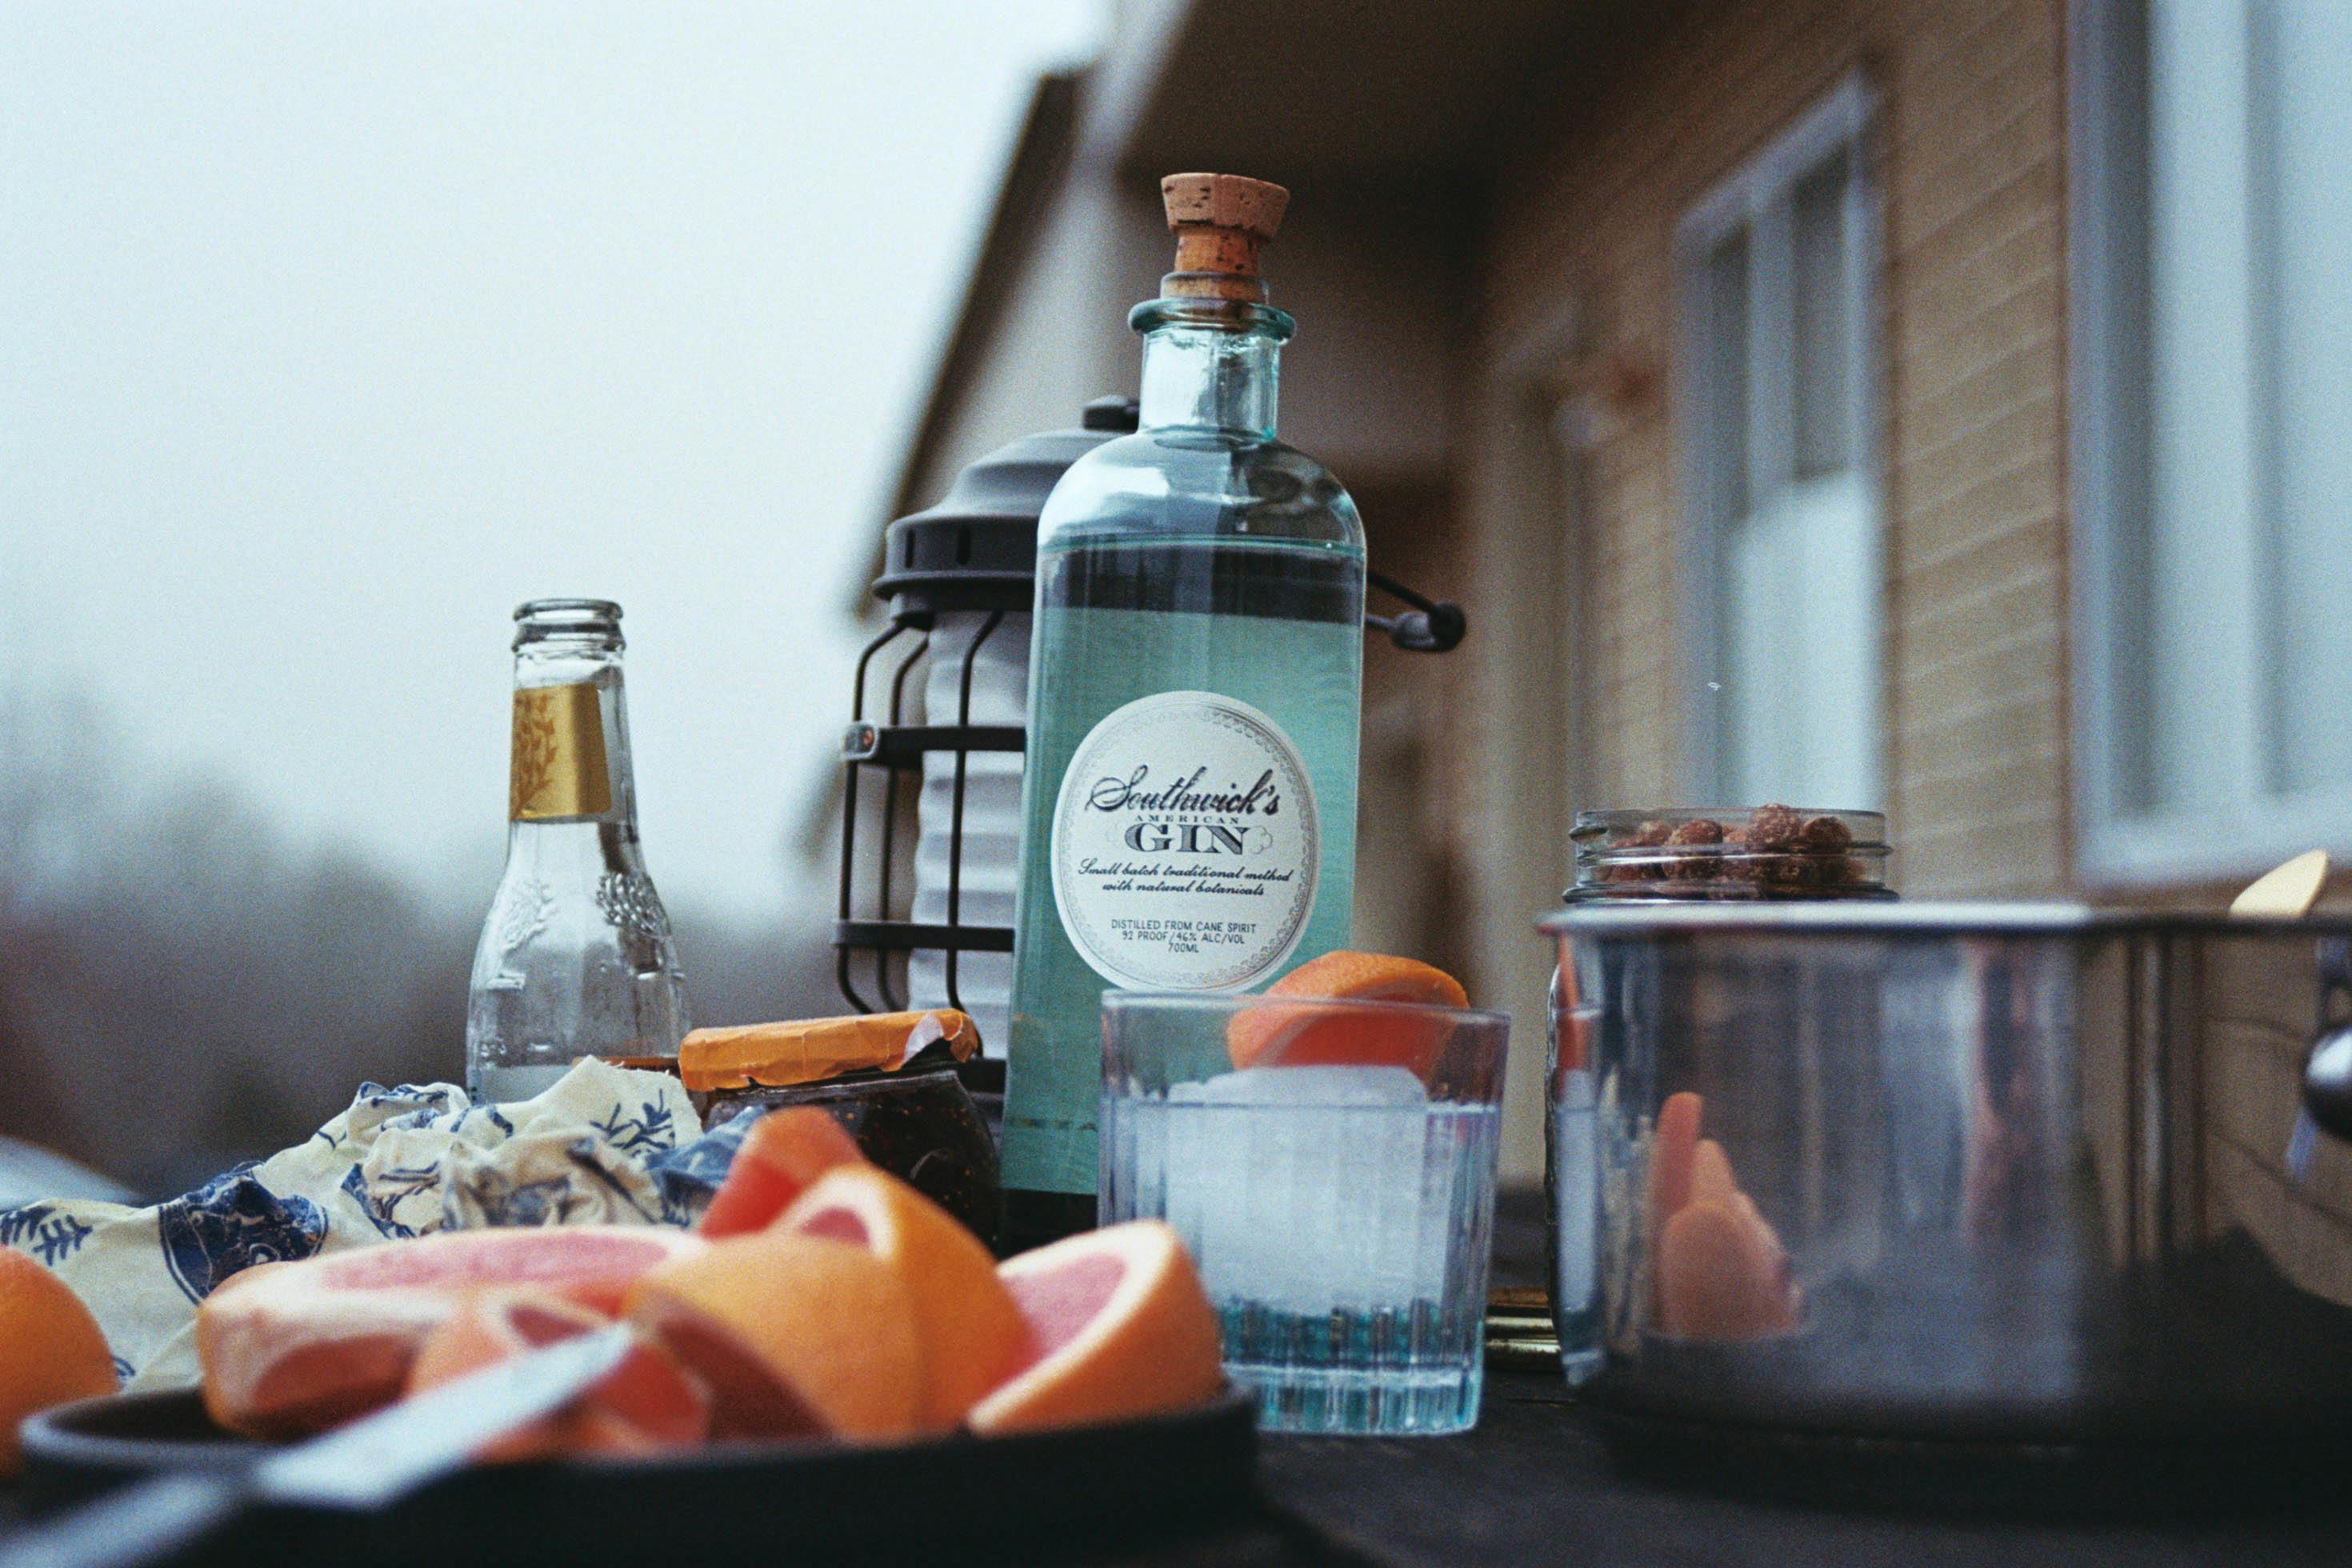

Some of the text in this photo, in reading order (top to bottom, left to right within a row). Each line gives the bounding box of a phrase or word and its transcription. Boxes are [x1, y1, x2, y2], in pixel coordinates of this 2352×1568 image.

[1084, 764, 1280, 815] Southwick's
[1134, 814, 1241, 825] AMERICAN
[1124, 822, 1250, 855] GIN
[1078, 858, 1294, 882] Small batch traditional method
[1102, 879, 1264, 896] with natural botanicals
[1111, 918, 1257, 934] DISTILLED FROM CANE SPIRIT
[1122, 930, 1134, 941] 92
[1202, 933, 1245, 945] ALC/VOL
[1168, 942, 1200, 954] 700ML
